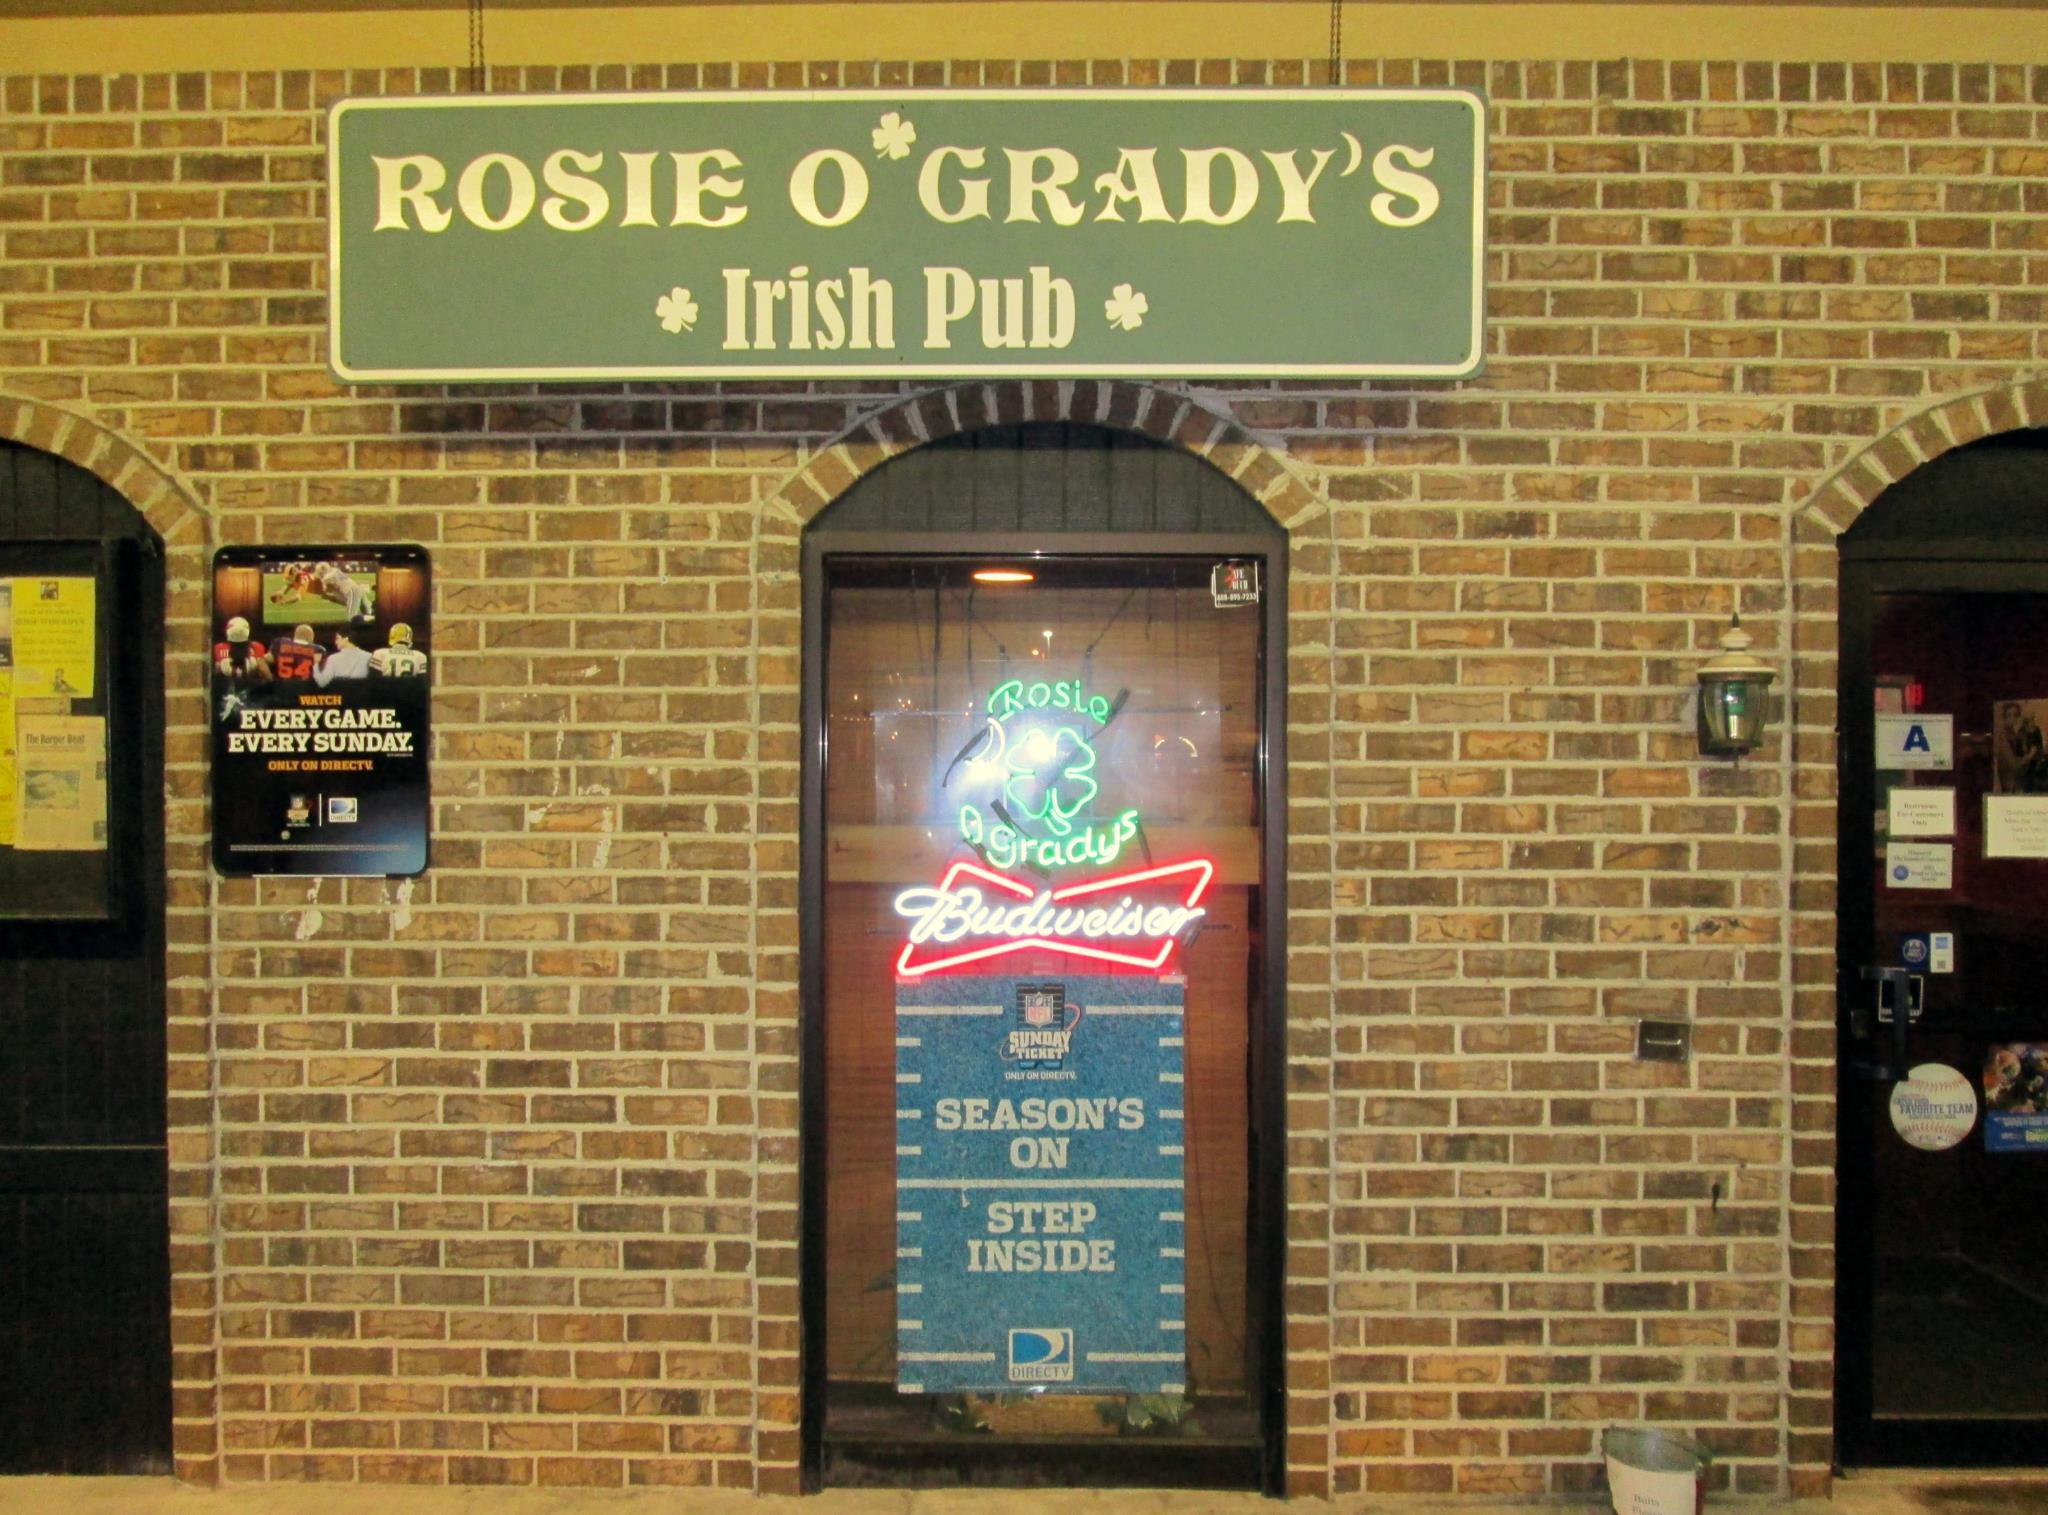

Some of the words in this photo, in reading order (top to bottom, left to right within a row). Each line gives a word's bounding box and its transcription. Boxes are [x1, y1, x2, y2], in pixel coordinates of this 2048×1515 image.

[371, 148, 748, 232] ROSIE
[722, 265, 895, 350] Irish
[922, 265, 1077, 349] Pub
[277, 656, 313, 680] 54
[300, 695, 342, 705] WATCH
[987, 680, 1108, 723] Rosie
[240, 708, 323, 729] EVERY
[324, 708, 402, 729] GAME.
[228, 732, 312, 753] EVERY
[313, 732, 414, 753] SUNDAY.
[1903, 725, 1930, 752] A
[268, 760, 298, 771] ONLY
[301, 760, 319, 771] ON
[895, 887, 1206, 943] Budweiser
[1009, 1031, 1072, 1055] SUNDAY
[1016, 1046, 1064, 1060] TICKET
[1005, 1071, 1025, 1080] ONLY
[1026, 1071, 1039, 1080] ON
[935, 1096, 1145, 1131] SEASON'S
[1947, 1103, 1973, 1114] TEAM
[1009, 1136, 1069, 1169] ON
[987, 1201, 1097, 1234] STEP
[967, 1239, 1116, 1273] INSIDE
[1011, 1367, 1070, 1378] DIRECTV
